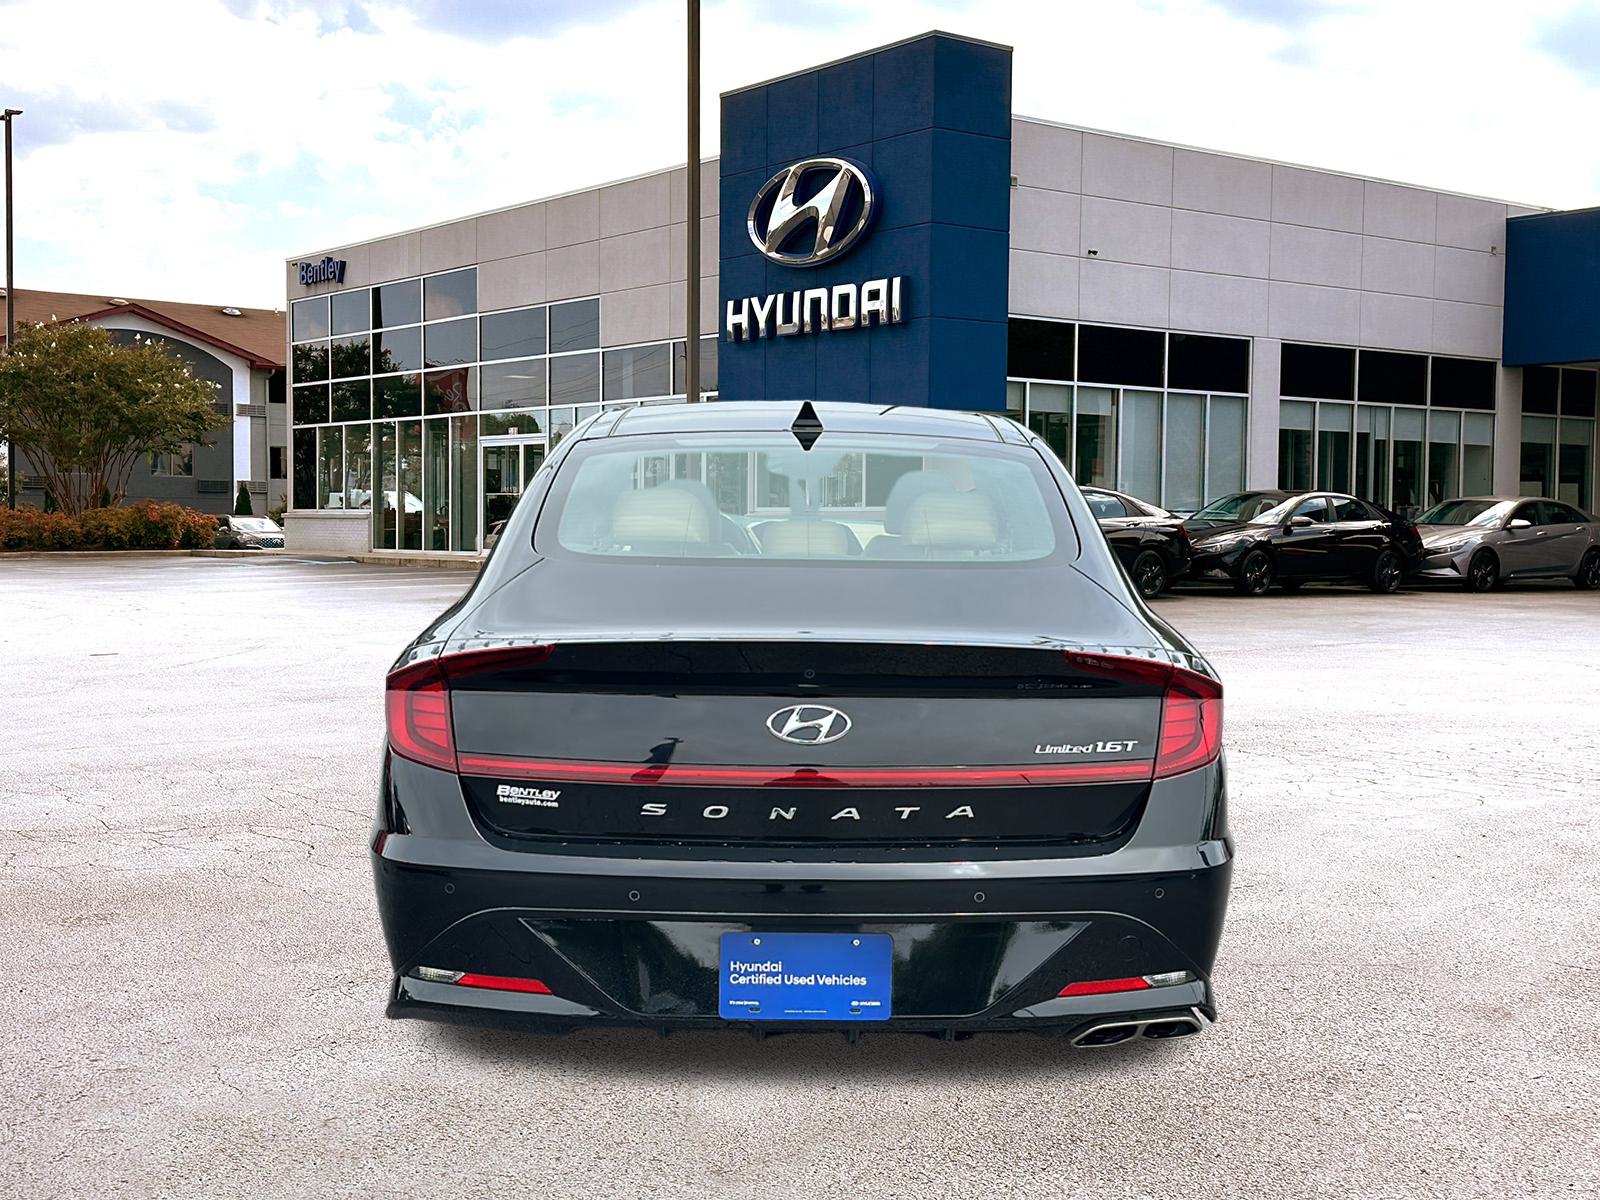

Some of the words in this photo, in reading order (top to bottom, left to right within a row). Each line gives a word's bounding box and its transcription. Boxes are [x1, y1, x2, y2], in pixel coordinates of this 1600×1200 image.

[299, 257, 343, 284] Bentley
[727, 276, 902, 341] HYUNDAI
[1034, 743, 1094, 754] Limited
[499, 796, 559, 807] bentleyauto.com
[640, 803, 976, 821] SONATA
[729, 961, 782, 974] Hyundai
[729, 973, 782, 985] Certified
[784, 974, 815, 985] Used
[816, 974, 867, 986] Vehicles
